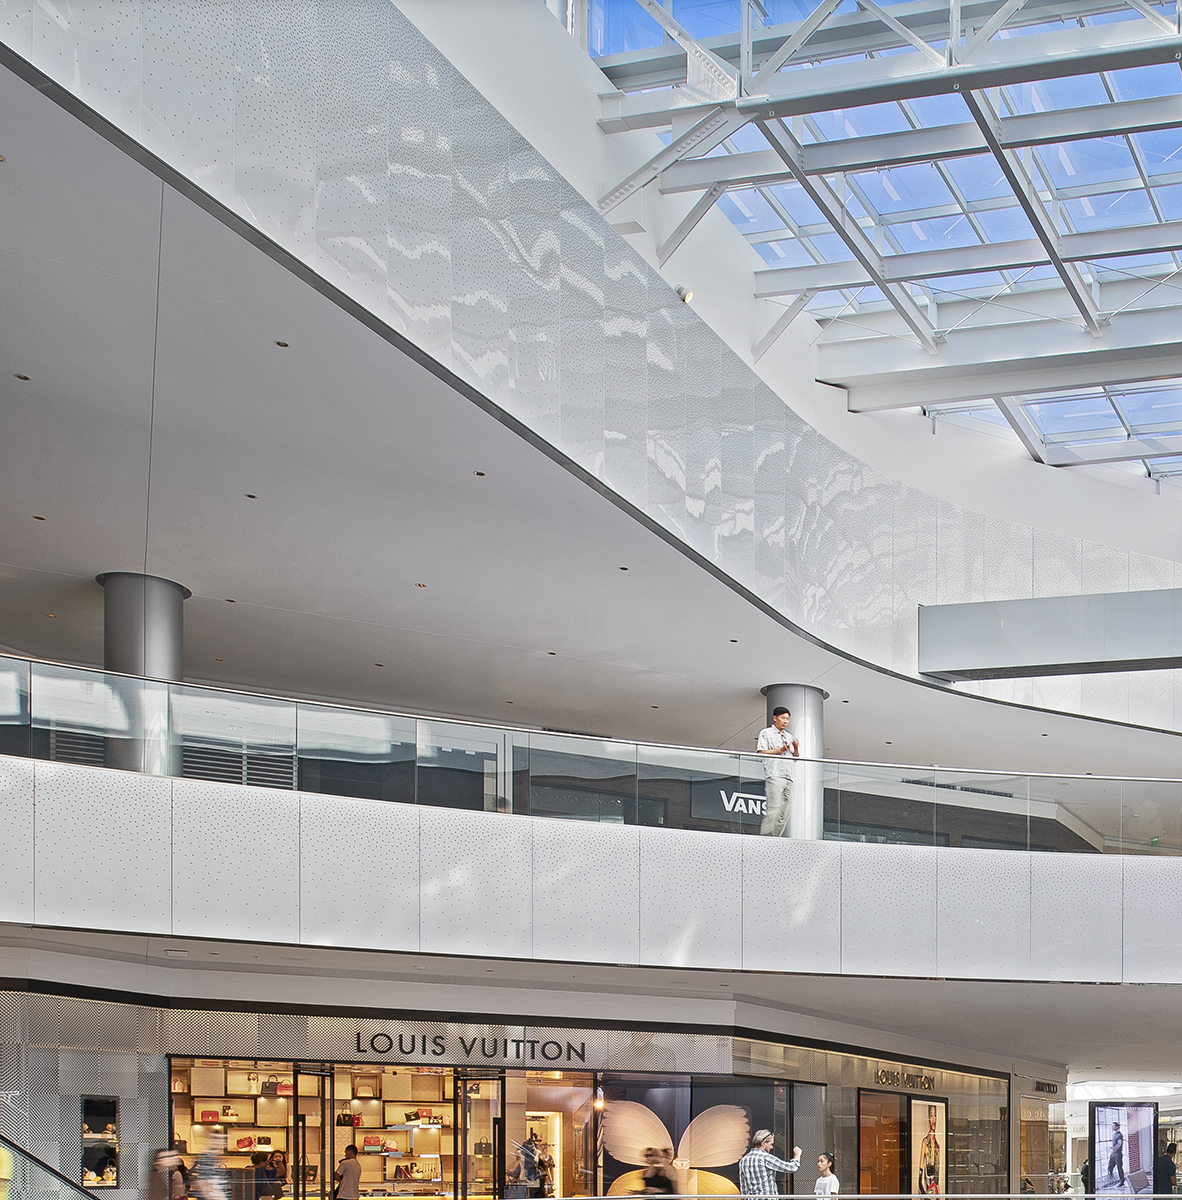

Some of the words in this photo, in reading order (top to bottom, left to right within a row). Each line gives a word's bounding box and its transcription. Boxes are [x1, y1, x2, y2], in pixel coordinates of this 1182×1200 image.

[356, 1032, 447, 1056] LOUIS
[459, 1036, 586, 1063] VUITTON
[875, 1069, 900, 1087] LOUIS
[901, 1072, 935, 1091] VUITTON
